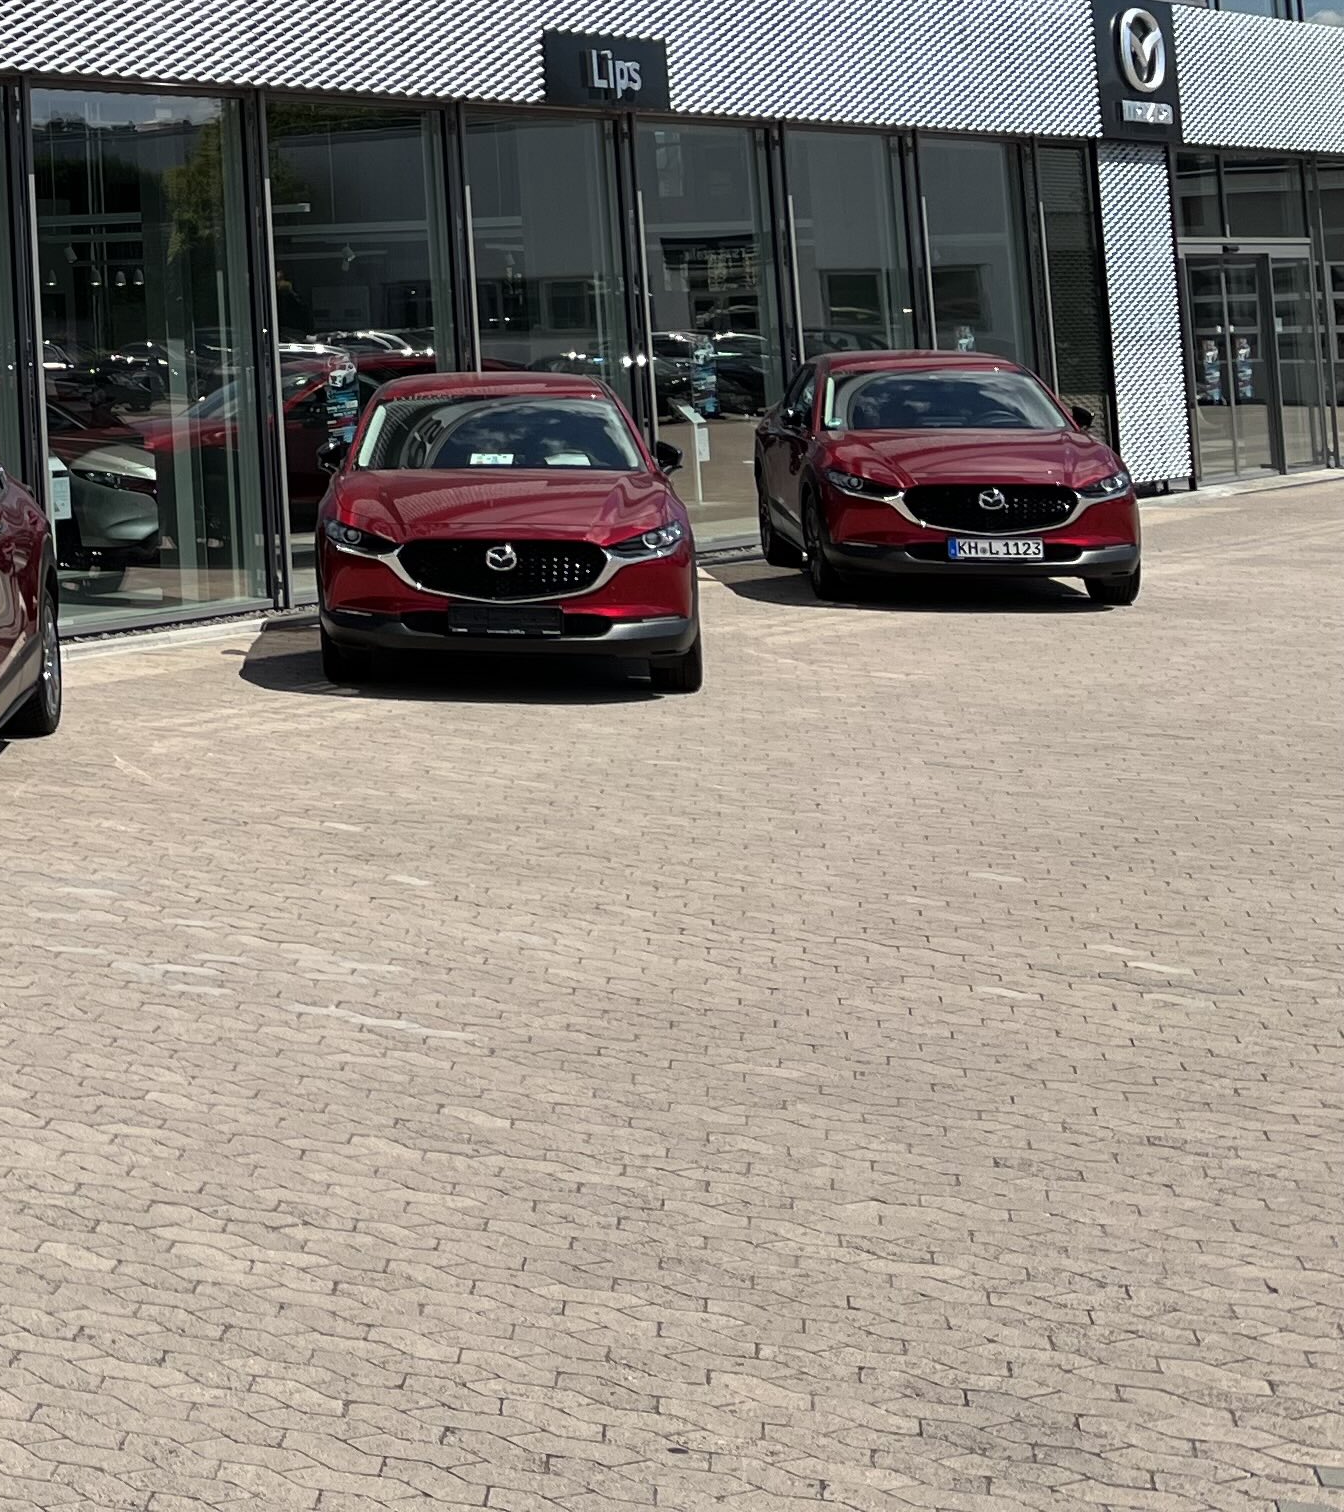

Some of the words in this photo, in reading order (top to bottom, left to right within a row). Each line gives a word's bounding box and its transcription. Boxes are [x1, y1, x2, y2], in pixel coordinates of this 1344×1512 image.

[591, 49, 642, 99] Lips
[958, 541, 978, 555] KH
[989, 541, 999, 555] L
[1003, 542, 1041, 555] 1123
